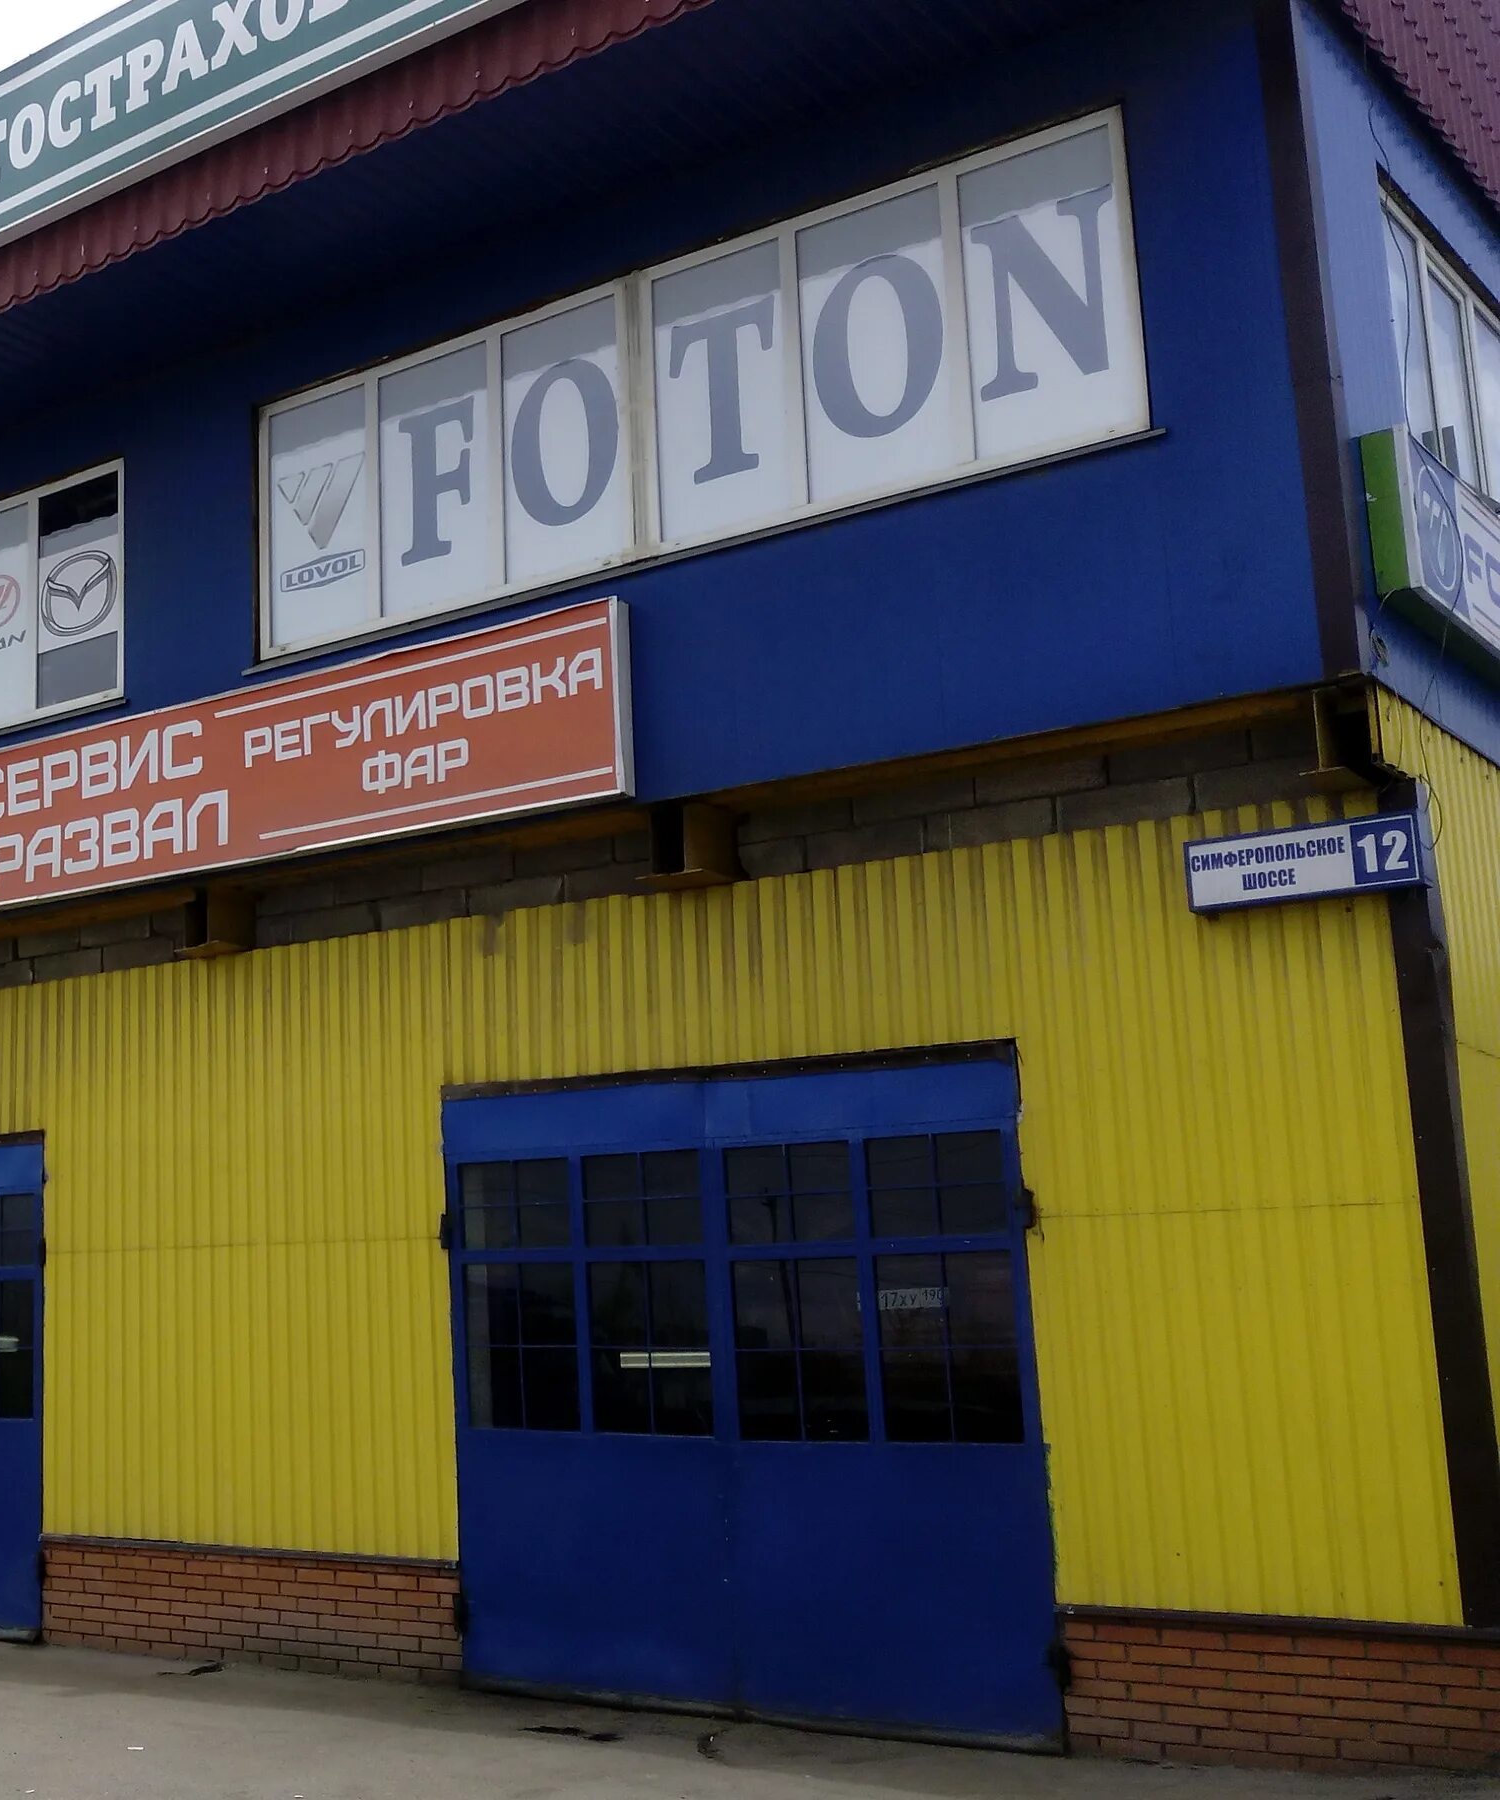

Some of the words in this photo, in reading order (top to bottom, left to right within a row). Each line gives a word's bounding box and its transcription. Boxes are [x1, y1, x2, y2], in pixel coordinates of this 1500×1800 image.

[401, 184, 1114, 568] FOTON
[285, 554, 362, 589] LOVOL
[244, 647, 603, 768] РЕГУЛИРОВКА
[362, 738, 469, 794] ФАР
[1191, 836, 1346, 873] СИМФЕРОПОЛЬСКОЕ
[1357, 830, 1410, 874] 12
[1242, 868, 1296, 891] ШОССЕ
